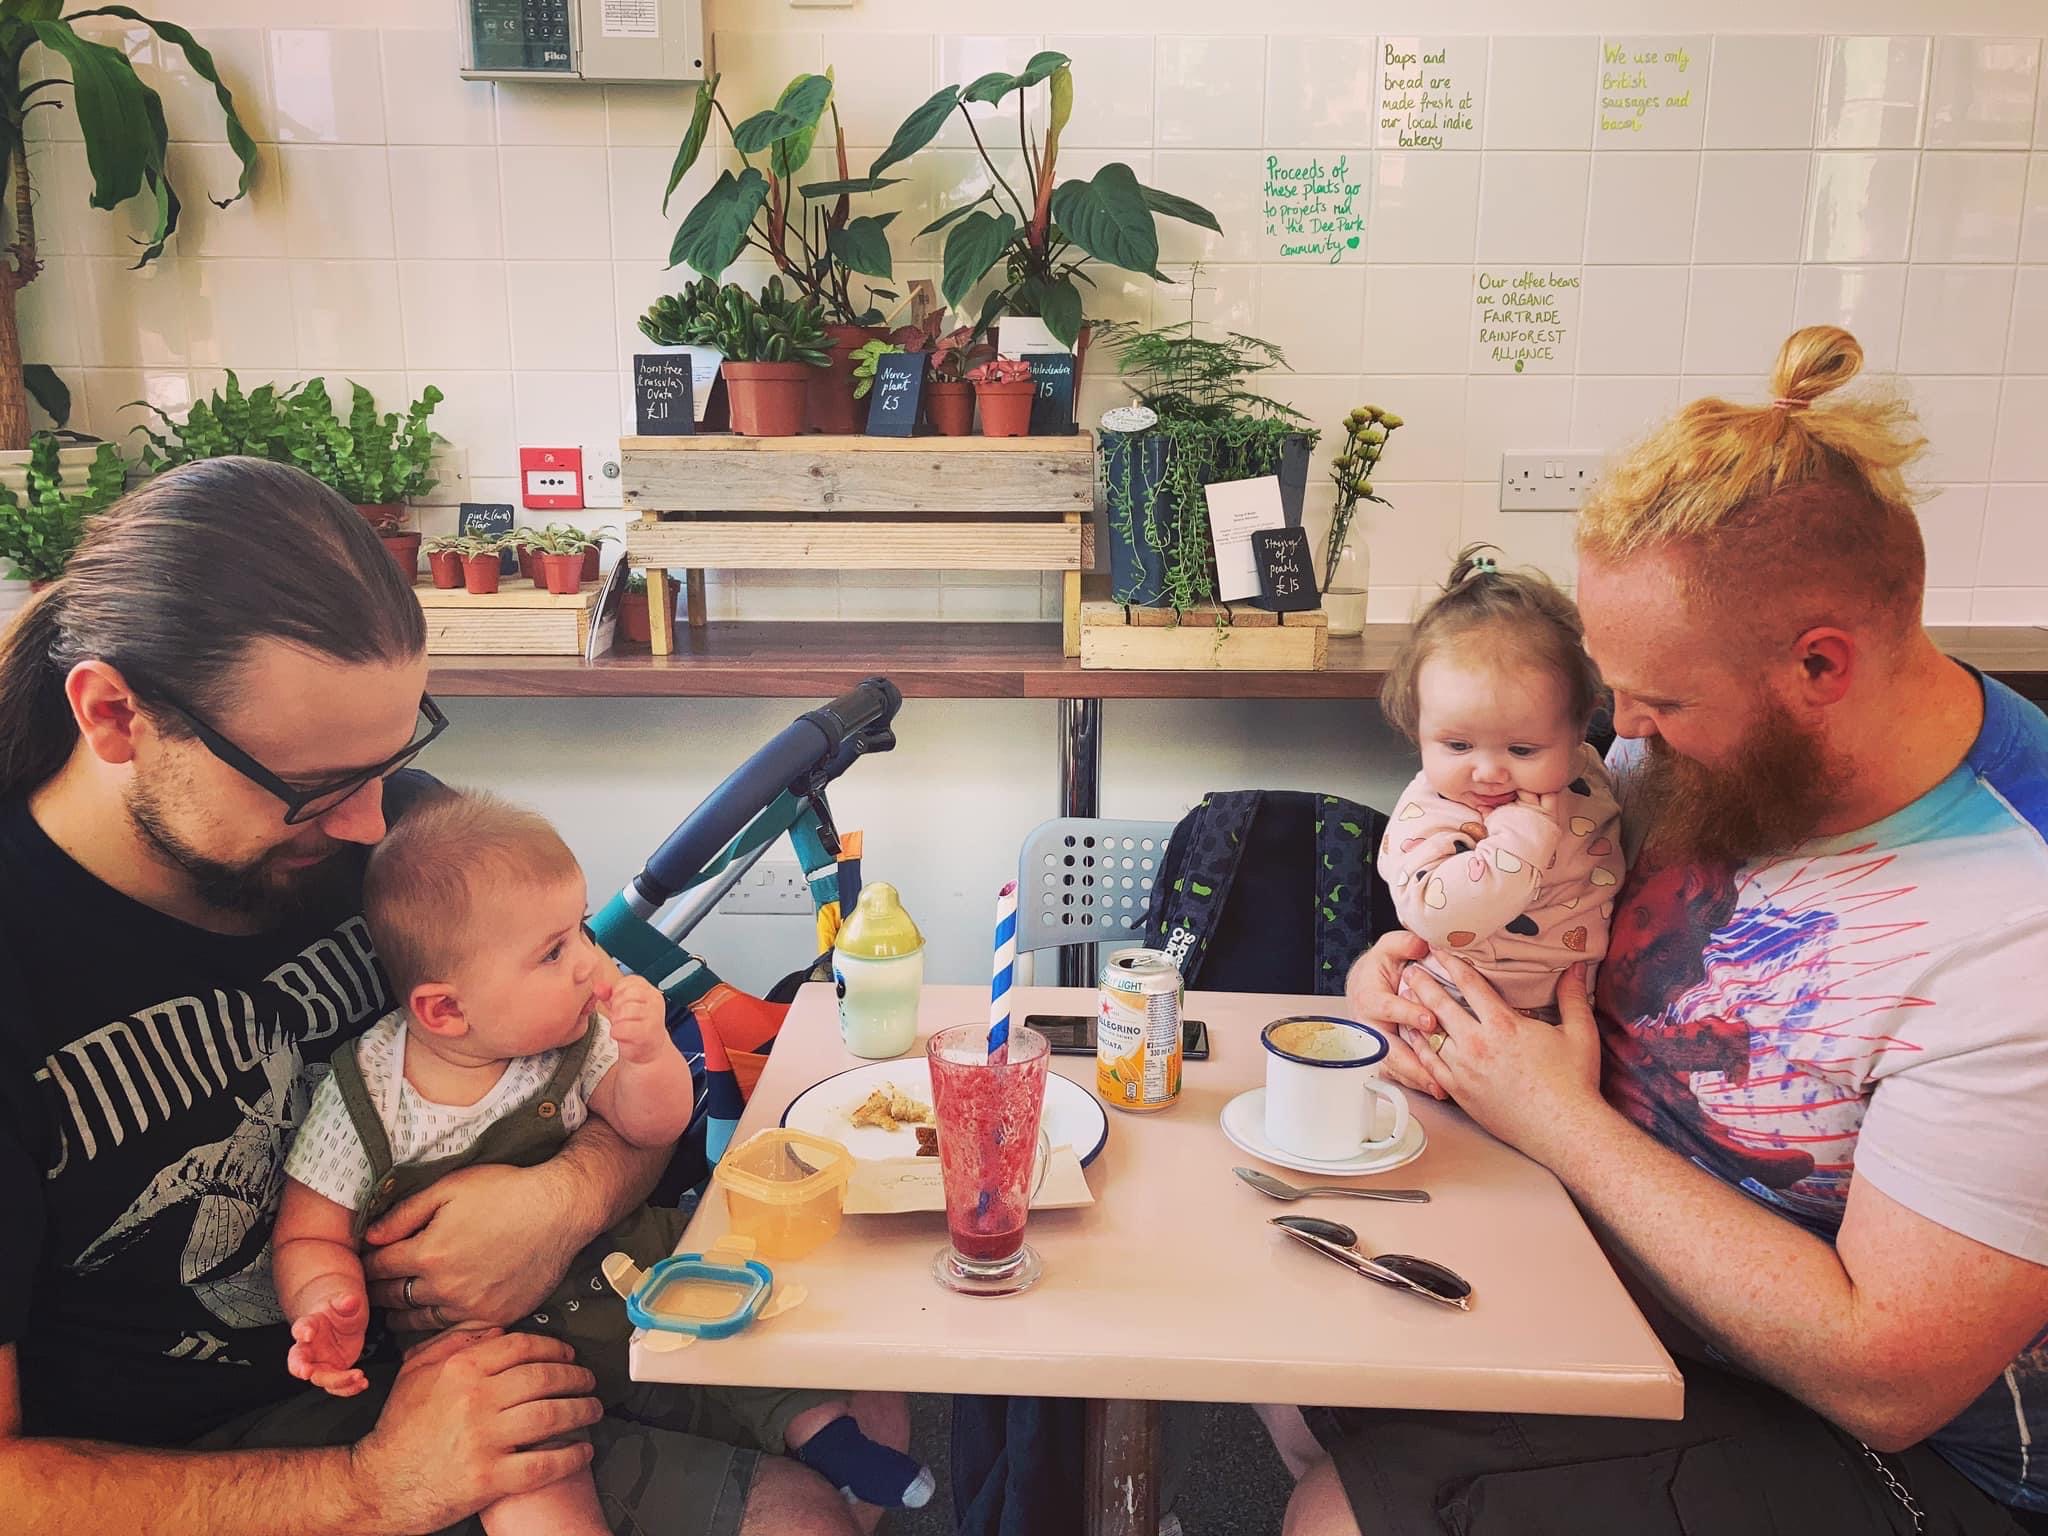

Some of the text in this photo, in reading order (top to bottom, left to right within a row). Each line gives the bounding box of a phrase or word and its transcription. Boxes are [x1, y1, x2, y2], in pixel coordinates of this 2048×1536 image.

[1384, 43, 1446, 71] Baps and
[1603, 42, 1690, 72] We use only
[1384, 70, 1451, 90] bread are
[1602, 71, 1647, 90] British
[1382, 91, 1473, 113] made fresh at
[1601, 90, 1691, 117] sausages and
[1381, 112, 1473, 130] our local indie
[1398, 129, 1443, 150] bakery
[1266, 154, 1349, 183] Proceeds of
[1263, 179, 1361, 206] these plants go
[1263, 200, 1277, 218] to
[1279, 196, 1327, 224] projects
[1265, 214, 1365, 236] in the Dee Park
[1479, 271, 1580, 290] Our coffee beans
[1476, 291, 1555, 307] are ORGANIC
[1479, 328, 1567, 344] RAINFOREST
[1491, 346, 1554, 361] ALLIANCE
[881, 367, 912, 380] Nerve
[881, 379, 912, 397] plant
[1037, 381, 1054, 399] 15
[646, 401, 668, 420] £11
[882, 395, 900, 410] £5
[1275, 547, 1287, 563] of
[1269, 560, 1299, 578] pearls
[1118, 980, 1143, 992] LIGHT
[33, 988, 275, 1180] IMMU
